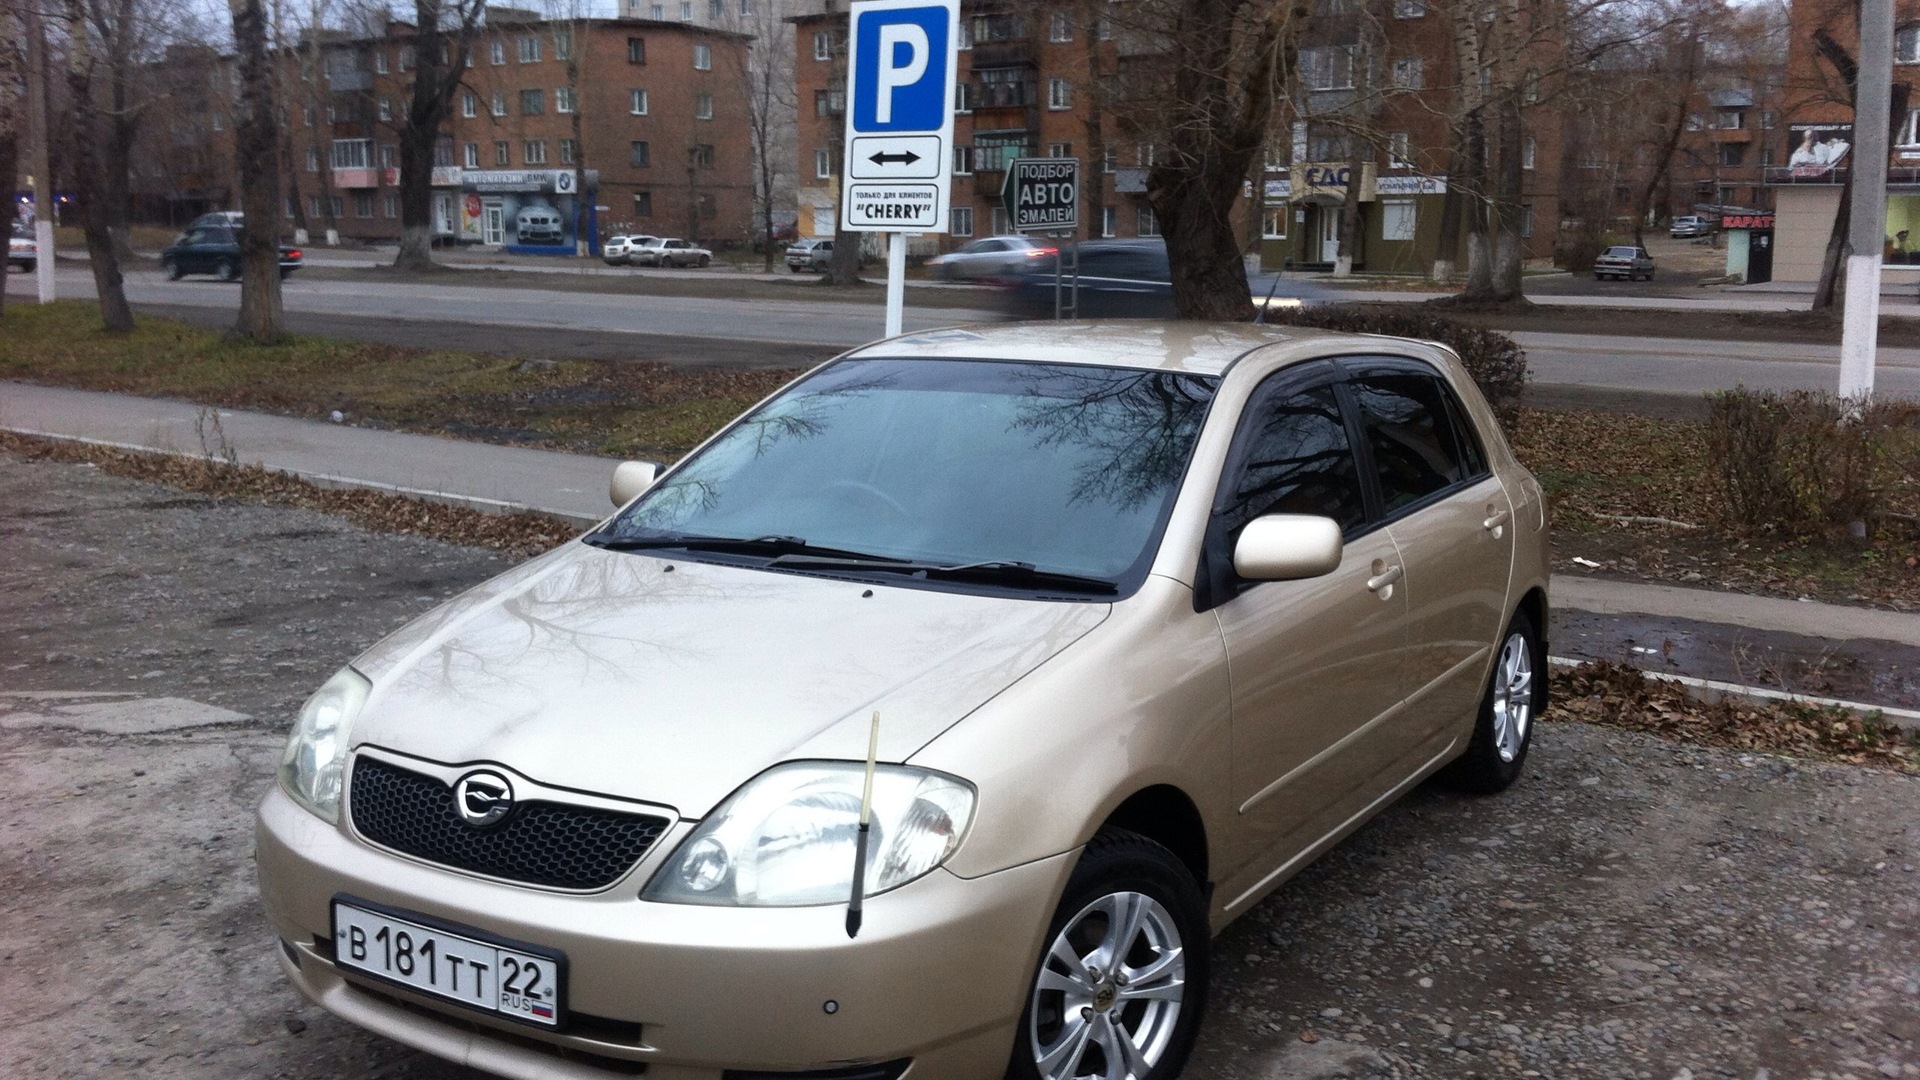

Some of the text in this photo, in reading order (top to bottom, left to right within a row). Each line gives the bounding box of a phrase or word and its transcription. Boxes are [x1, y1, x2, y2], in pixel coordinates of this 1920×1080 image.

[876, 23, 929, 123] P
[527, 172, 548, 183] BMW
[1020, 164, 1073, 180] ПОДБОР
[1020, 182, 1074, 205] АВТО
[856, 203, 931, 219] "CHERRY"
[1020, 205, 1073, 223] ЭМАЛЕЙ
[501, 993, 531, 1011] RUS
